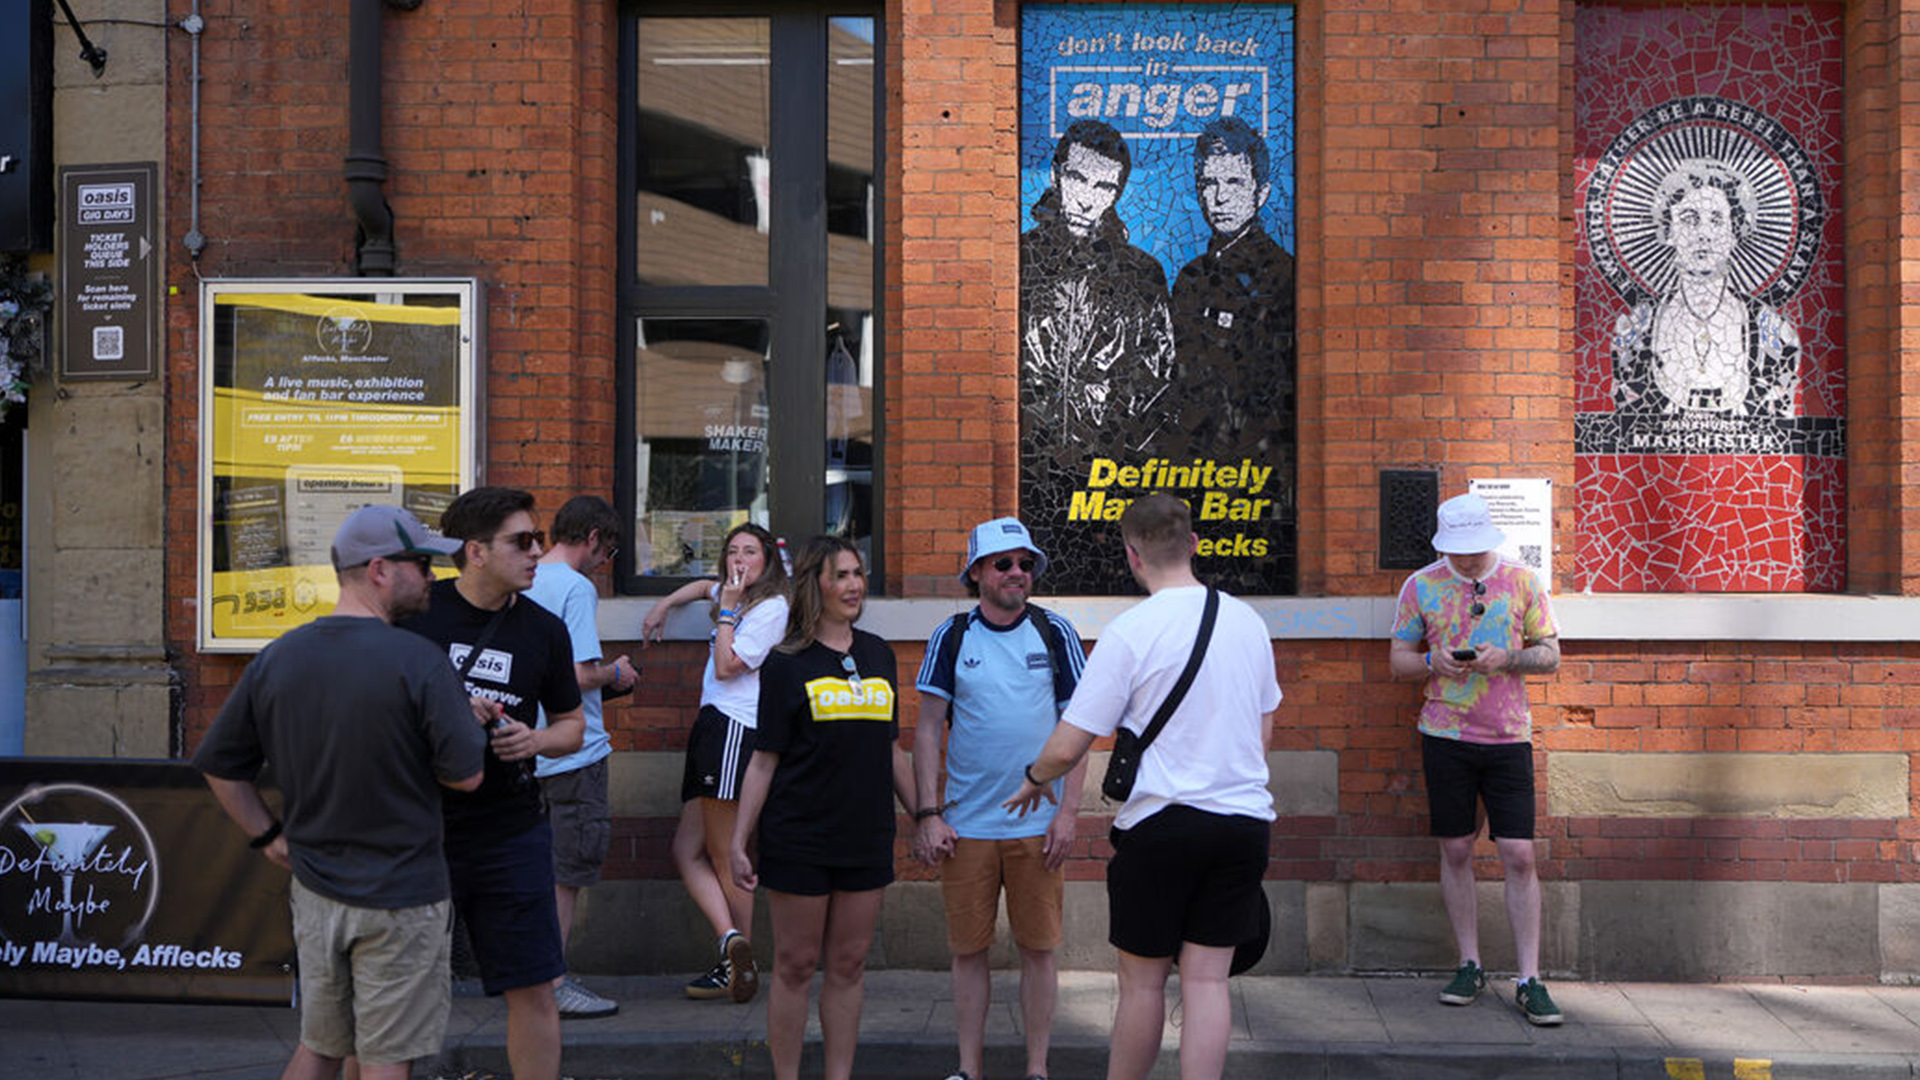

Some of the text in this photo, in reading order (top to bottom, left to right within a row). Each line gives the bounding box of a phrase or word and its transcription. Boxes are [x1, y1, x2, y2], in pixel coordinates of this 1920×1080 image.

[1058, 31, 1260, 57] don't look back
[1145, 58, 1169, 76] in
[1067, 83, 1251, 128] anger
[1658, 104, 1683, 122] BE
[1692, 104, 1707, 117] A
[1715, 104, 1776, 141] REBEL
[1593, 119, 1652, 191] RATHER
[1781, 139, 1815, 197] THAN
[84, 189, 129, 205] oasis
[83, 209, 130, 221] GIG DAYS
[1802, 208, 1816, 221] A
[90, 232, 125, 243] TICKET
[84, 242, 129, 252] HOLDERS
[84, 258, 131, 269] THIS SIDE
[91, 250, 124, 261] QUEUE
[1777, 231, 1815, 292] SLAVE
[85, 284, 129, 294] Scan here
[92, 293, 137, 303] remaining
[83, 302, 132, 311] ticket slots
[264, 376, 424, 389] A live music, exhibition
[262, 390, 425, 403] and fan bar experience
[274, 414, 304, 422] ENTRY
[704, 424, 767, 440] SHAKER
[709, 438, 763, 453] MAKER
[1633, 434, 1774, 449] MANCHESTER
[303, 480, 349, 488] opening
[1088, 458, 1273, 494] Definitely
[1200, 491, 1270, 521] Bar
[456, 655, 504, 672] osis
[819, 688, 888, 708] oasis
[0, 845, 148, 891] Definitely
[27, 884, 111, 929] Maybe
[31, 942, 126, 969] Maybe,
[131, 944, 243, 969] Afflecks
